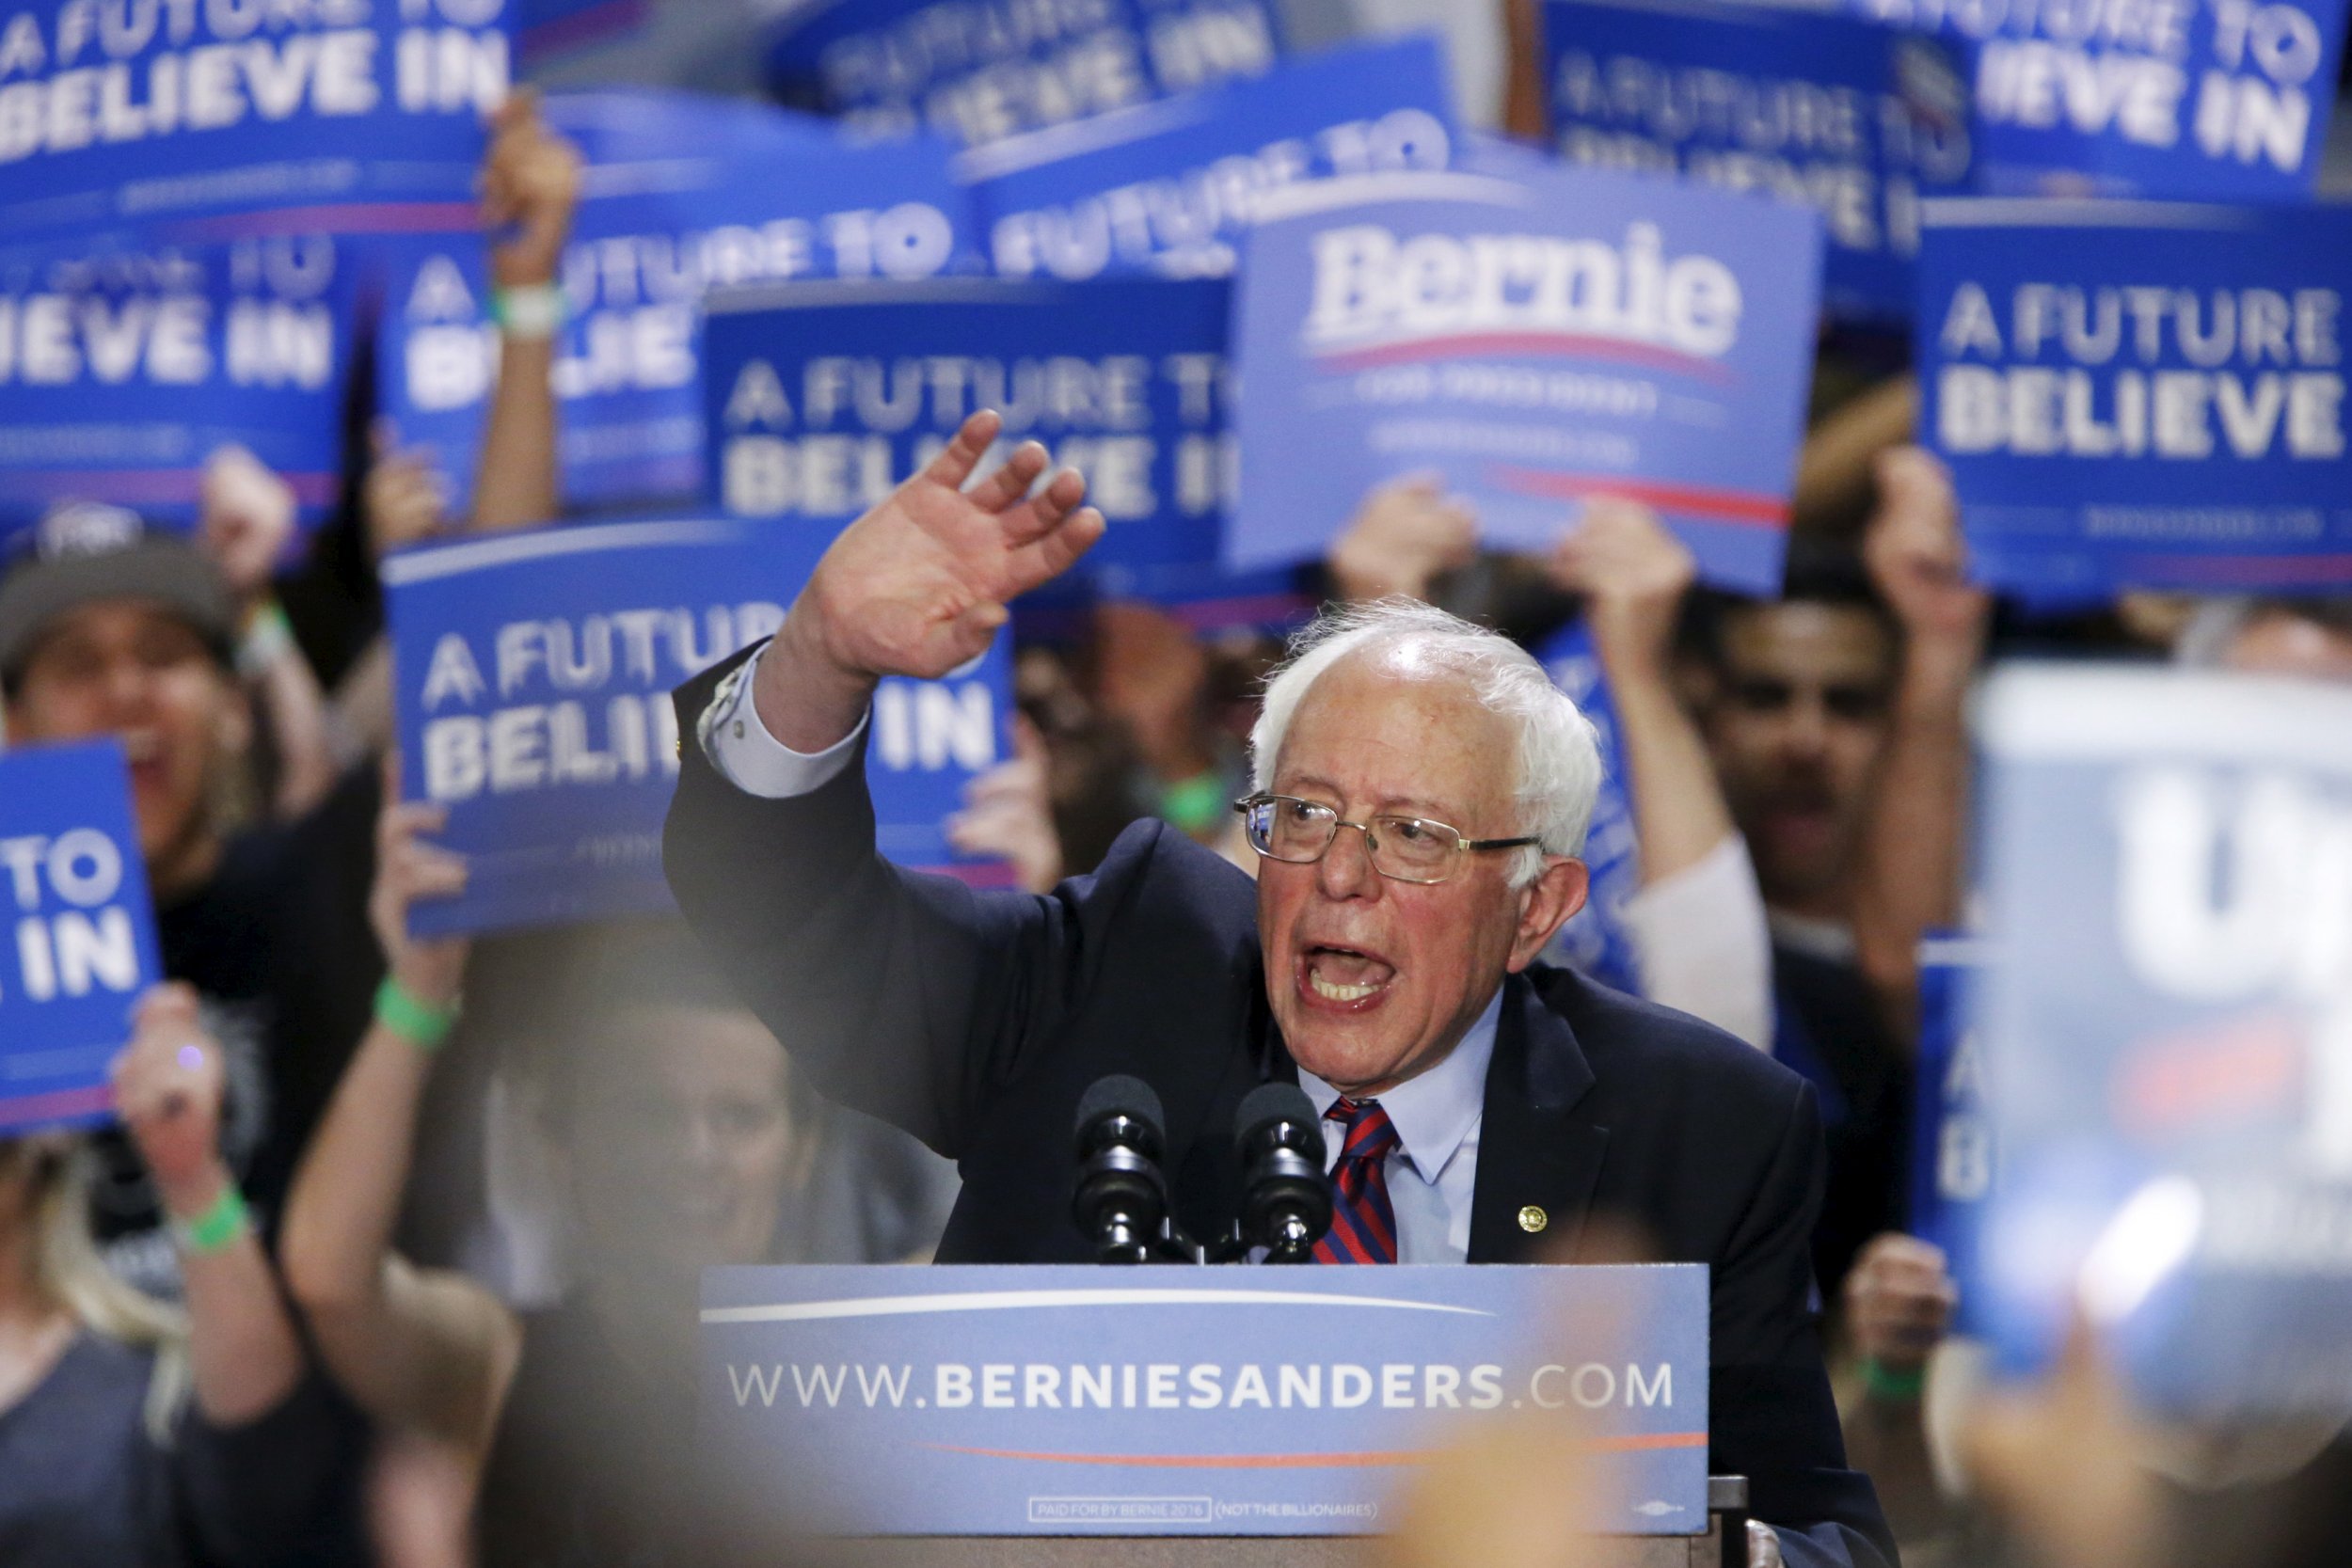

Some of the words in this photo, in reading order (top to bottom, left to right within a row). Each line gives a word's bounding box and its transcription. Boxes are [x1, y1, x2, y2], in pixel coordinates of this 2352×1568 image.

[0, 29, 377, 164] BELIEVE
[395, 26, 512, 117] IN
[2195, 68, 2311, 175] IN
[559, 216, 815, 322] UTURE
[818, 201, 955, 282] TO
[1302, 219, 1743, 359] Bernie
[225, 295, 335, 393] IN
[1939, 280, 2005, 361] A
[2011, 281, 2344, 368] FUTURE
[722, 356, 796, 435] A
[802, 353, 1154, 435] FUTURE
[1936, 361, 2345, 461] BELIEVE
[421, 630, 486, 712] A
[873, 677, 997, 773] IN
[0, 827, 123, 910] TO
[16, 904, 141, 1004] IN
[726, 1362, 1675, 1410] WWW.BERNIESANDERS.COM
